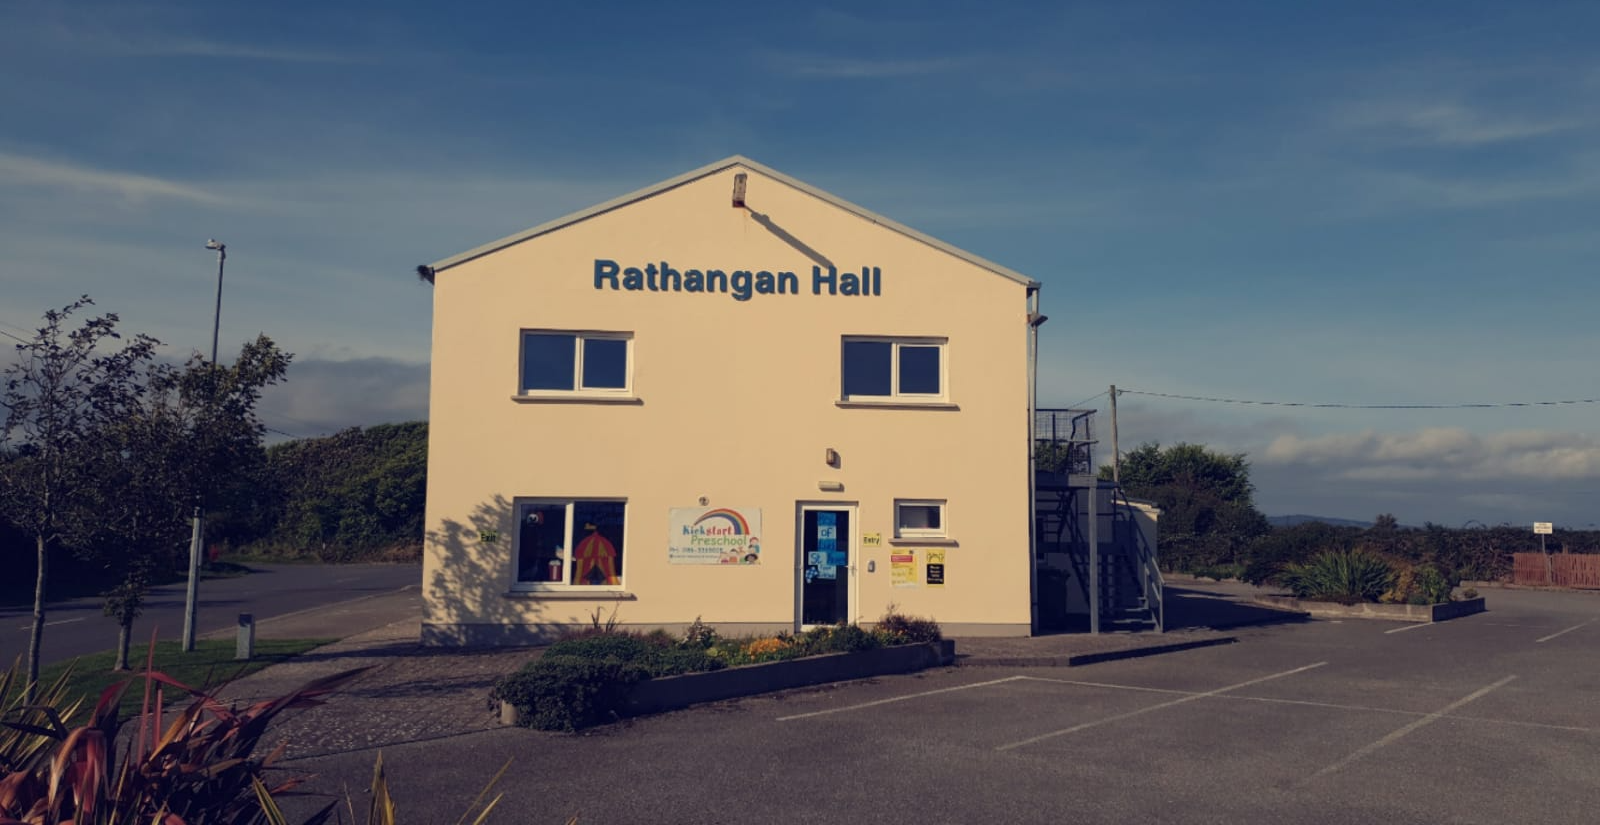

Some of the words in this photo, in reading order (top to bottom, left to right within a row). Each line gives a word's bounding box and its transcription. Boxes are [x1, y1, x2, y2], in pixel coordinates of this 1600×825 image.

[594, 259, 799, 301] Rathangan
[812, 265, 881, 296] Hall
[691, 534, 747, 546] Preschool
[863, 536, 880, 546] Entry
